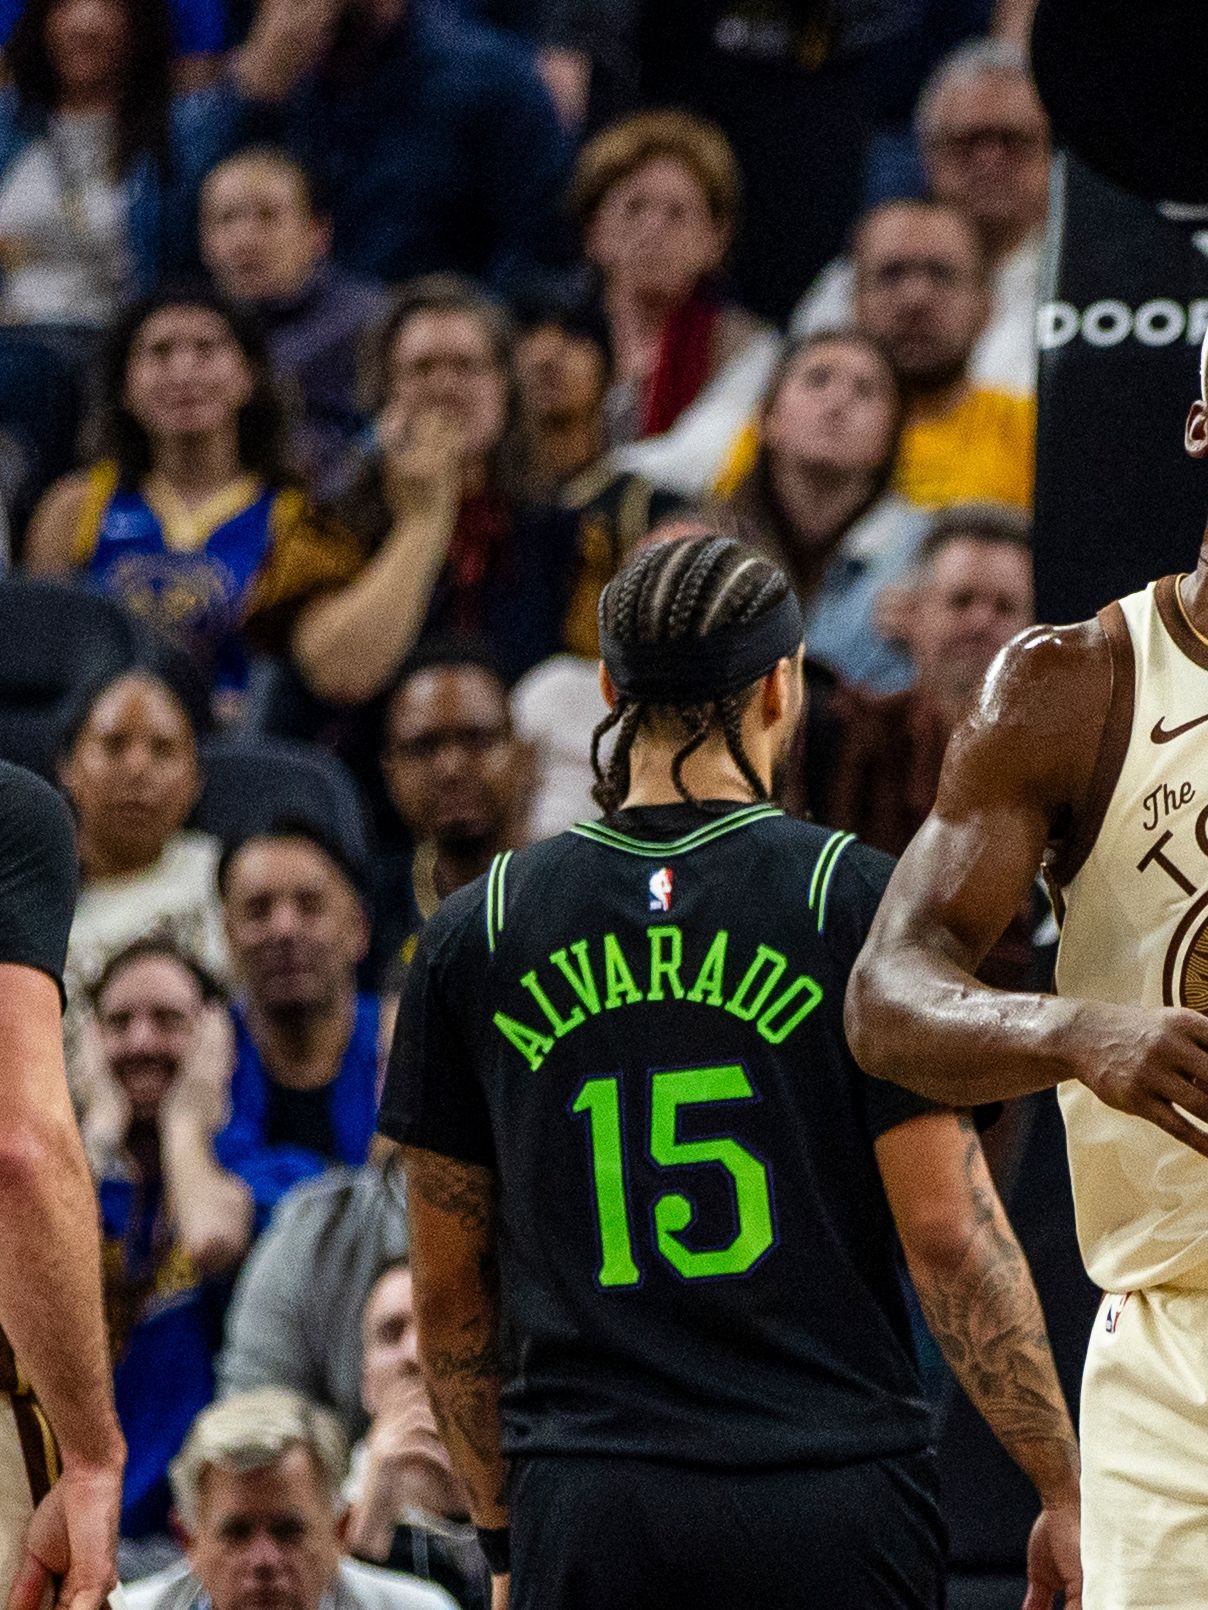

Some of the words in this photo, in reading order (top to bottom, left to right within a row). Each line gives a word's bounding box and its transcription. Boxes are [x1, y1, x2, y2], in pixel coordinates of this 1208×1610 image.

[1143, 781, 1196, 831] The
[492, 924, 824, 1072] ALVARADO
[569, 1062, 778, 1289] 15
